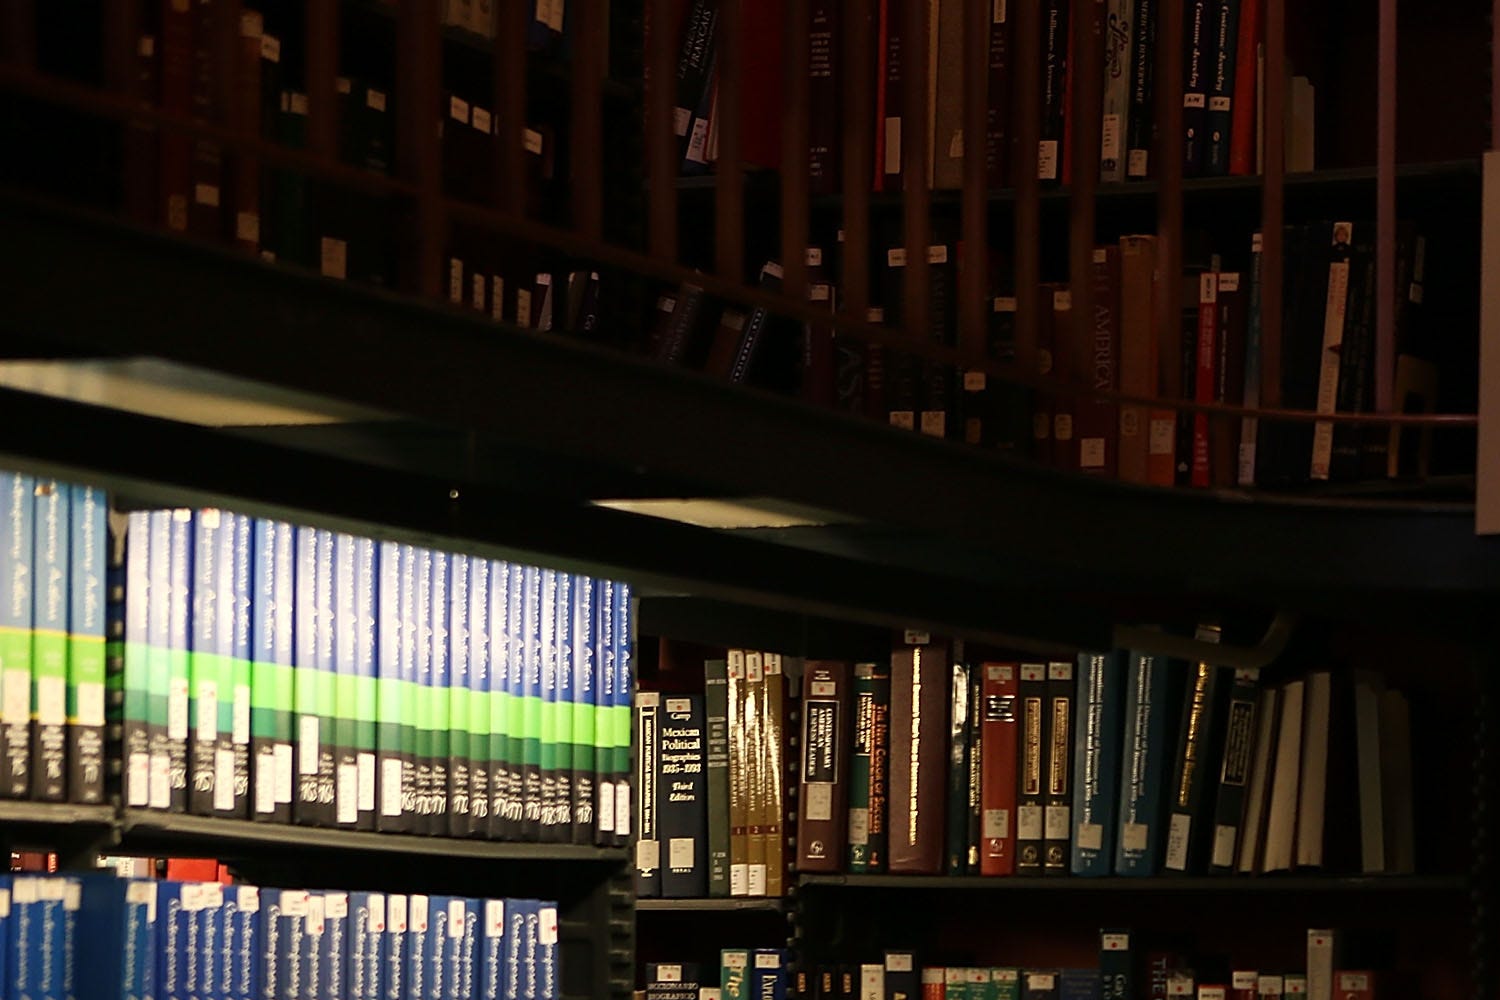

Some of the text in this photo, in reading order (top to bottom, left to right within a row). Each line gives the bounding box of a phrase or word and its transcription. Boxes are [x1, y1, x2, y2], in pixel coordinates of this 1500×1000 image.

[662, 728, 700, 739] Mexican
[662, 739, 701, 751] Political
[726, 967, 744, 998] The
[1112, 974, 1128, 996] Gay
[1151, 957, 1168, 994] THE
